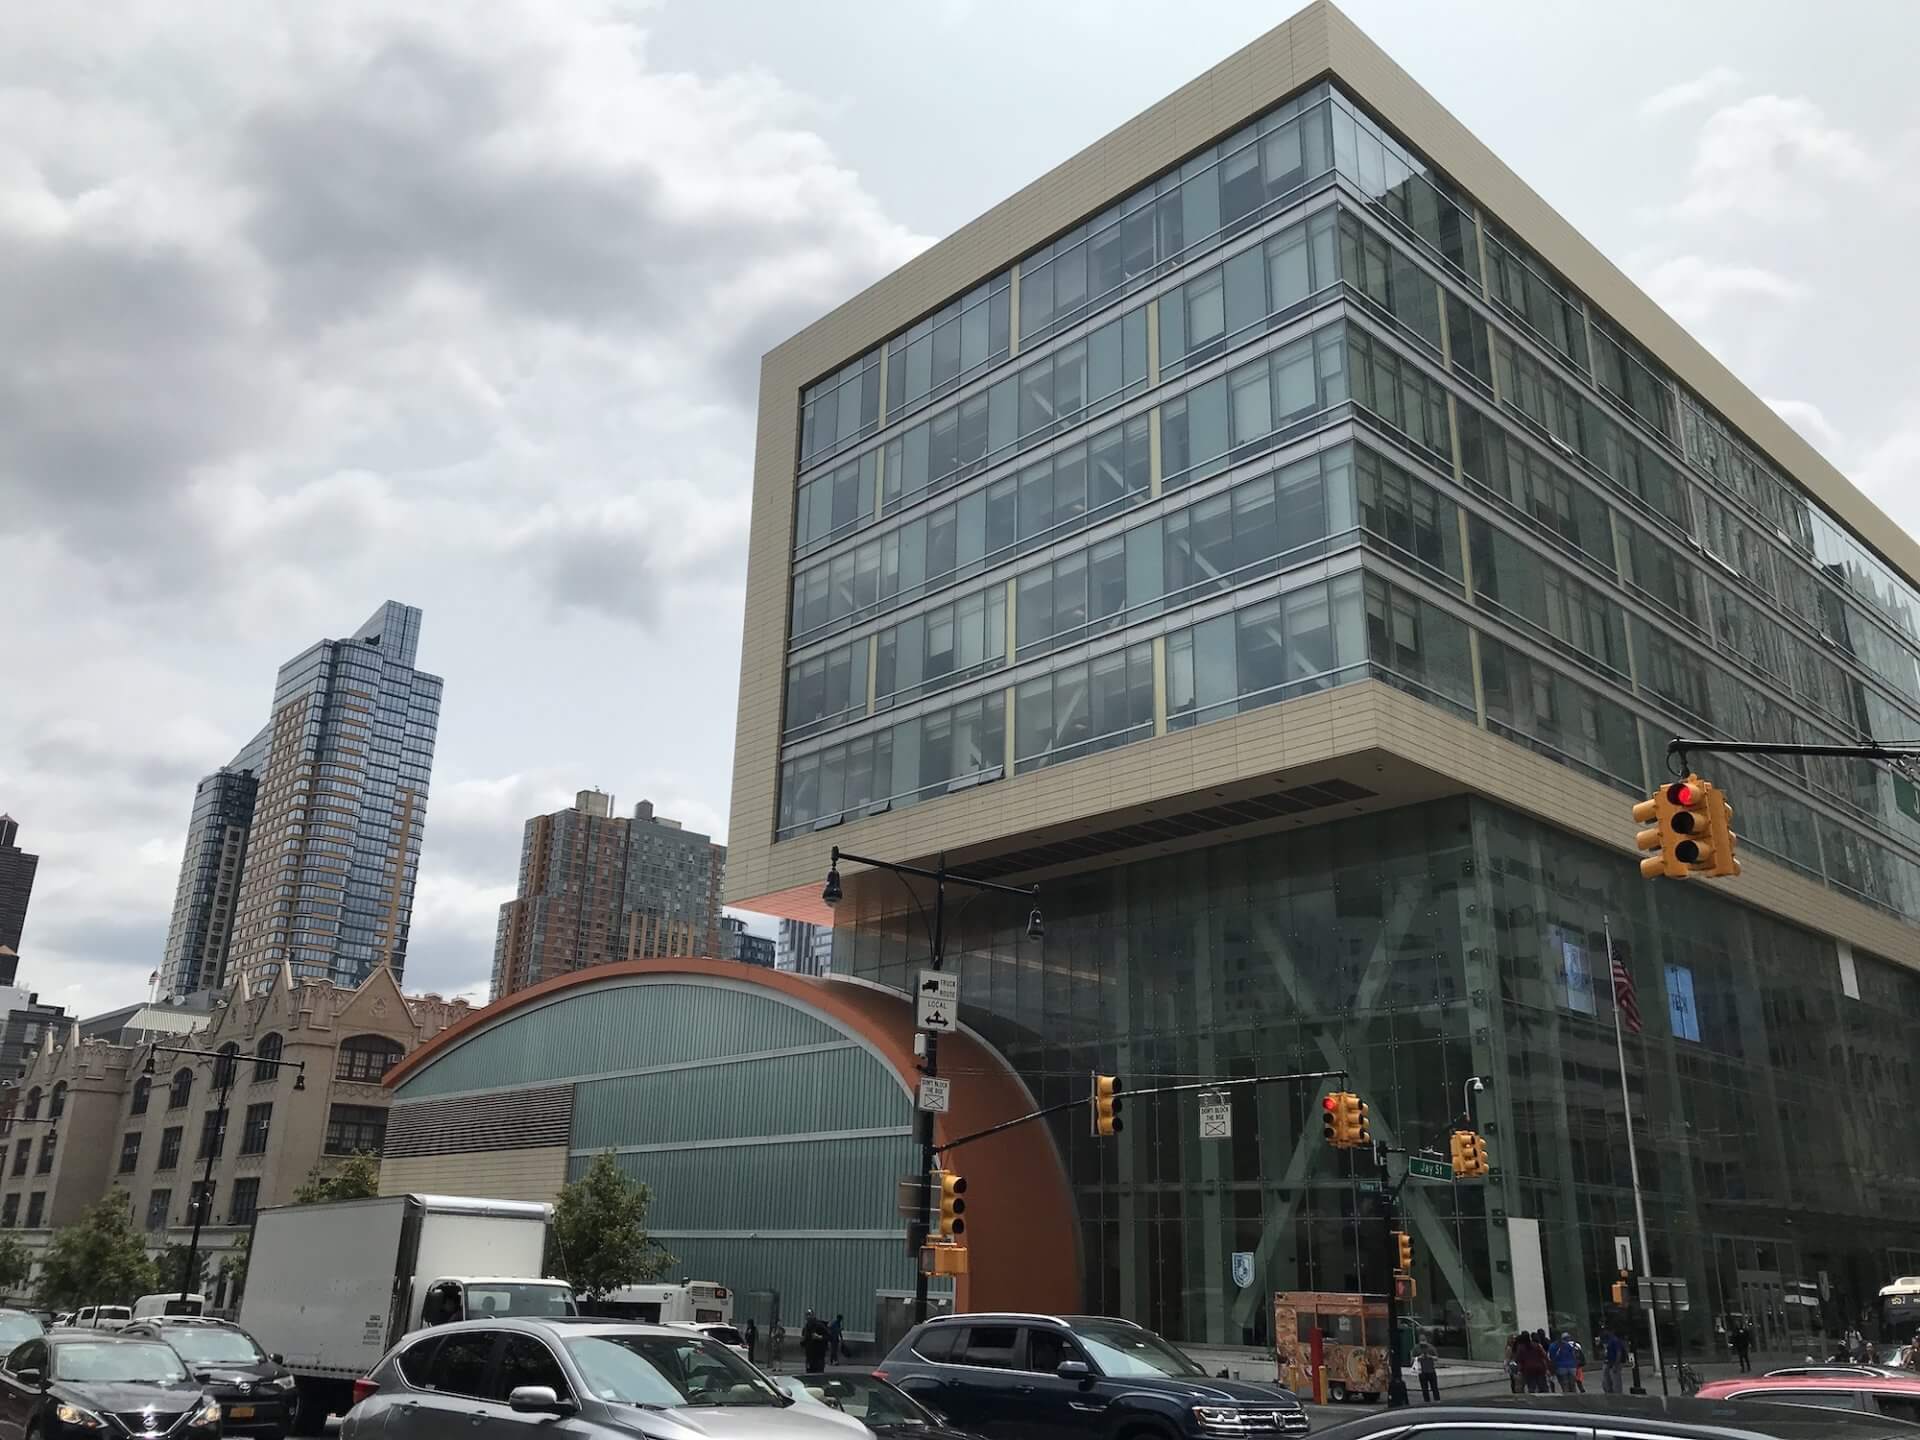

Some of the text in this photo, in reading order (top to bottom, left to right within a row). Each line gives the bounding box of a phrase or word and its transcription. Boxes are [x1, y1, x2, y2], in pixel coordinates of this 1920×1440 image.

[928, 1000, 947, 1009] LOCAL
[1420, 1161, 1443, 1176] Jay St
